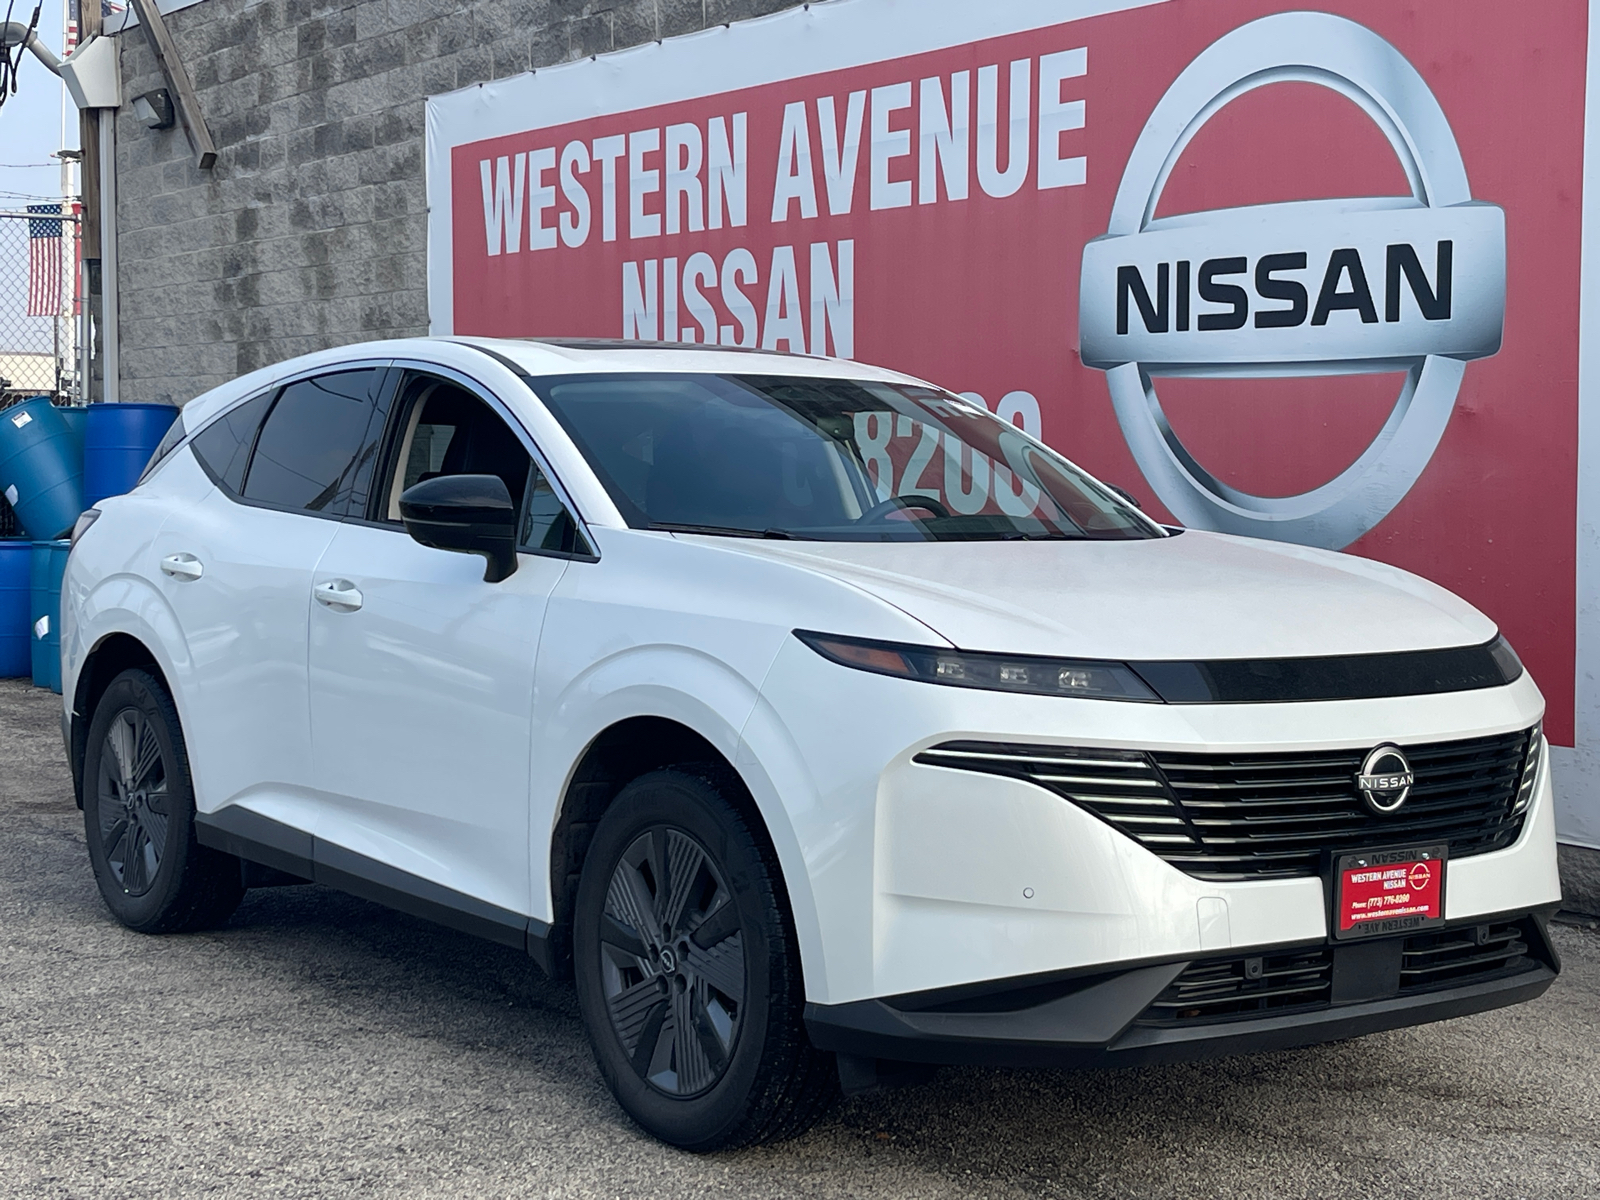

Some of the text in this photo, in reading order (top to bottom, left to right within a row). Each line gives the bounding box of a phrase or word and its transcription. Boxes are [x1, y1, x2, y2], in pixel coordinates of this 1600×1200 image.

[480, 47, 1088, 257] WESTERN AVENUE
[1117, 240, 1453, 335] NISSAN
[623, 240, 855, 359] NISSAN
[853, 391, 1042, 518] 8200
[1360, 774, 1414, 789] NISSAN
[1371, 850, 1417, 865] NISSAN
[1351, 869, 1407, 883] WESTERN AVENUE
[1383, 879, 1406, 890] NISSAN
[1367, 896, 1383, 909] (773)
[1381, 916, 1420, 931] WESTERN
